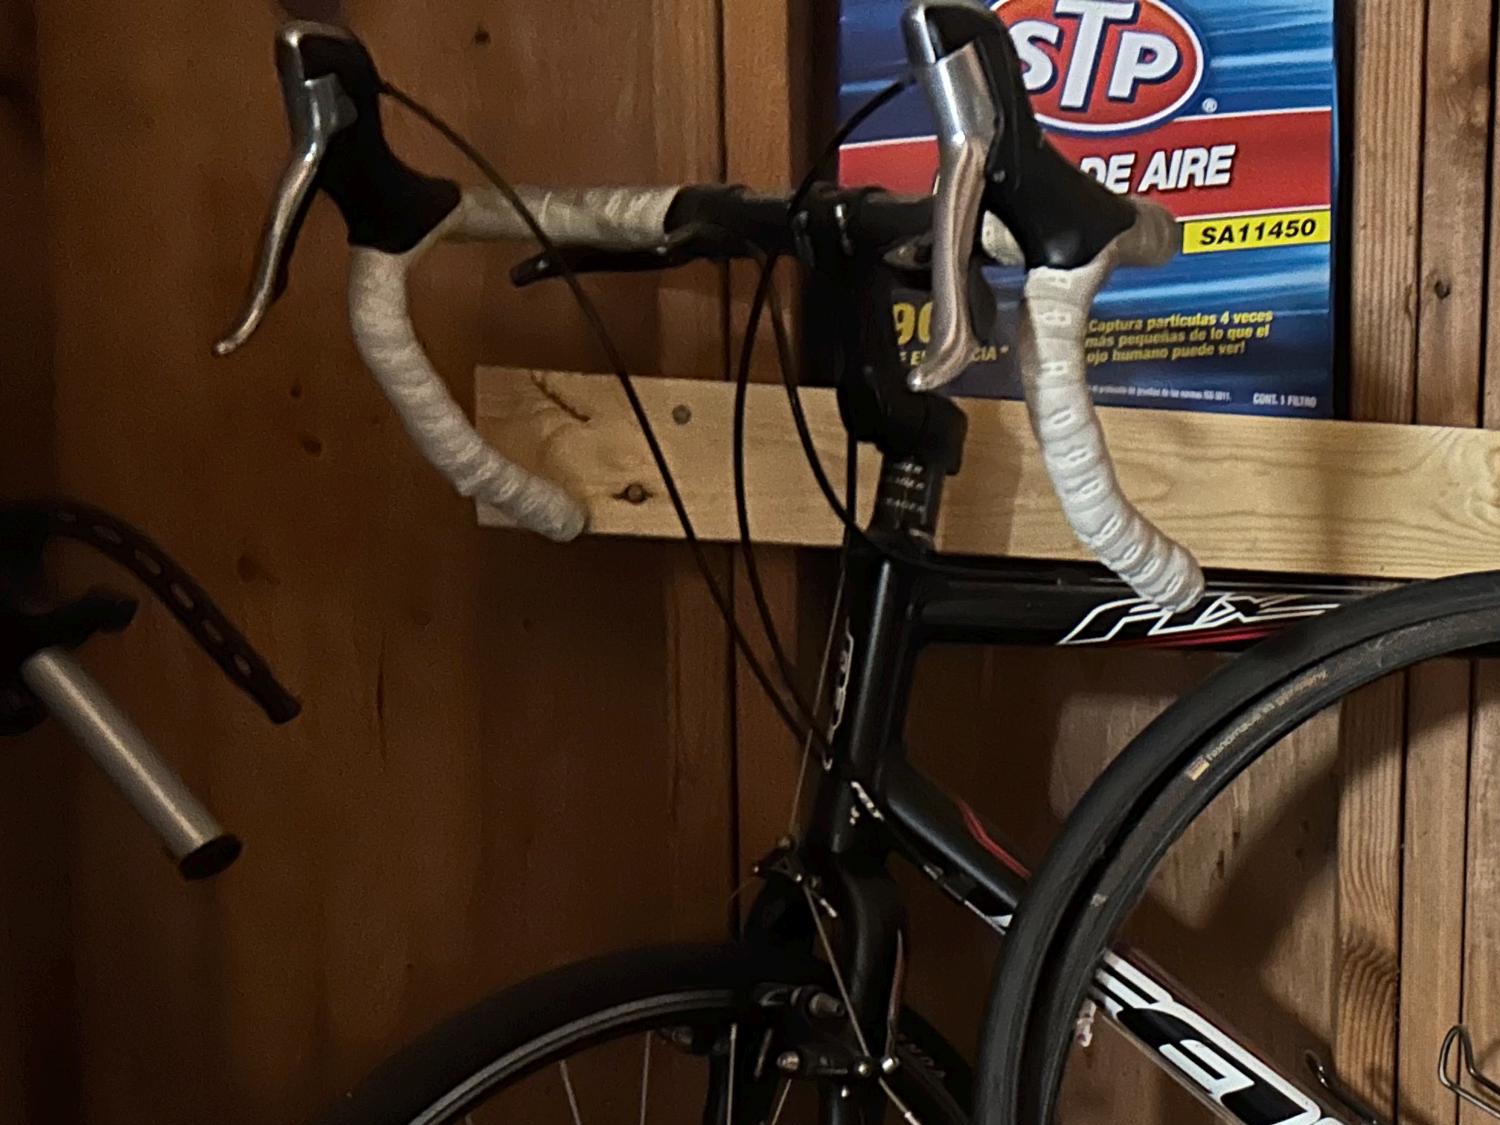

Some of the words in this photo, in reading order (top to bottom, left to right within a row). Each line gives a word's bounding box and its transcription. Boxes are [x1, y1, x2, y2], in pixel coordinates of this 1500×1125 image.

[1008, 0, 1178, 108] STP
[1080, 153, 1135, 195] DE
[1137, 144, 1236, 194] AIRE
[1200, 217, 1317, 246] SA11450
[1088, 315, 1143, 334] Captura
[1146, 311, 1217, 332] partículas
[1219, 310, 1230, 326] 4
[1232, 309, 1274, 325] veces
[1085, 333, 1115, 348] más
[1118, 327, 1186, 347] pequeñas
[1189, 327, 1206, 342] de
[1210, 326, 1223, 339] lo
[1226, 325, 1254, 341] que
[1256, 323, 1271, 338] el
[1086, 352, 1109, 367] ojo
[1112, 346, 1169, 363] humano
[1171, 343, 1215, 361] puede
[1252, 391, 1280, 407] CONT.
[1286, 394, 1318, 409] FILTRO
